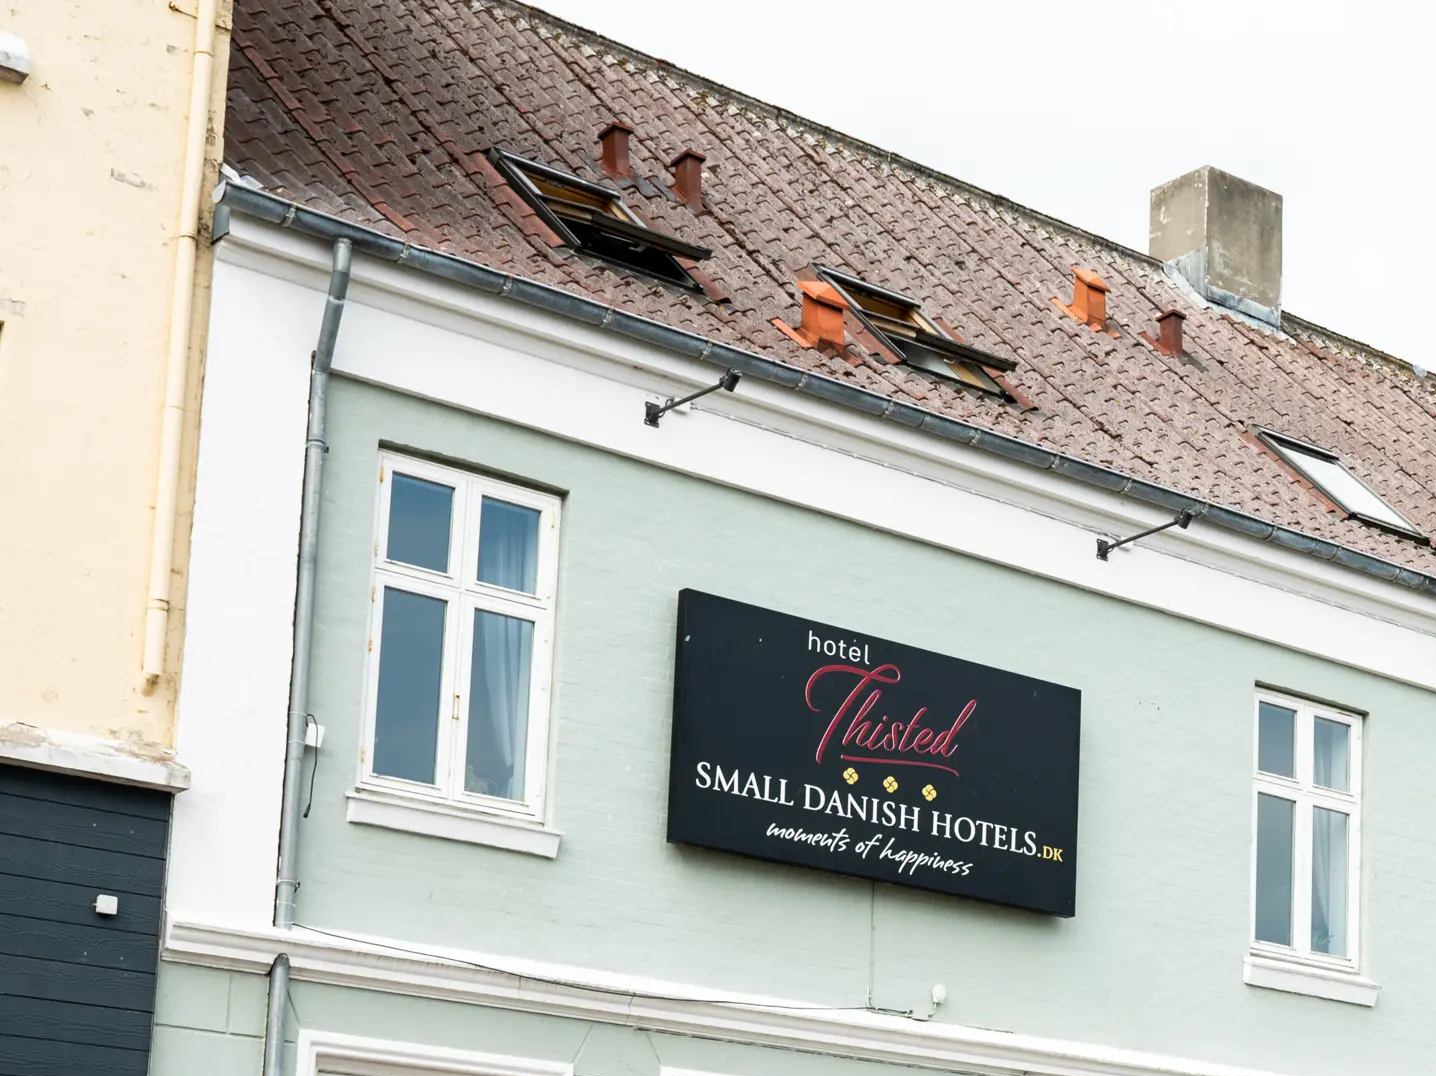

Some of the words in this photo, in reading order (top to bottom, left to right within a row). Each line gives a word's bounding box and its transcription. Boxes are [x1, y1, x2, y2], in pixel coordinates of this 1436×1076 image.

[808, 630, 870, 665] hotel
[805, 664, 977, 764] Thisted
[695, 761, 794, 807] SMALL
[803, 784, 921, 832] DANISH
[766, 823, 850, 852] moments
[855, 834, 882, 859] of
[879, 837, 973, 875] happiness
